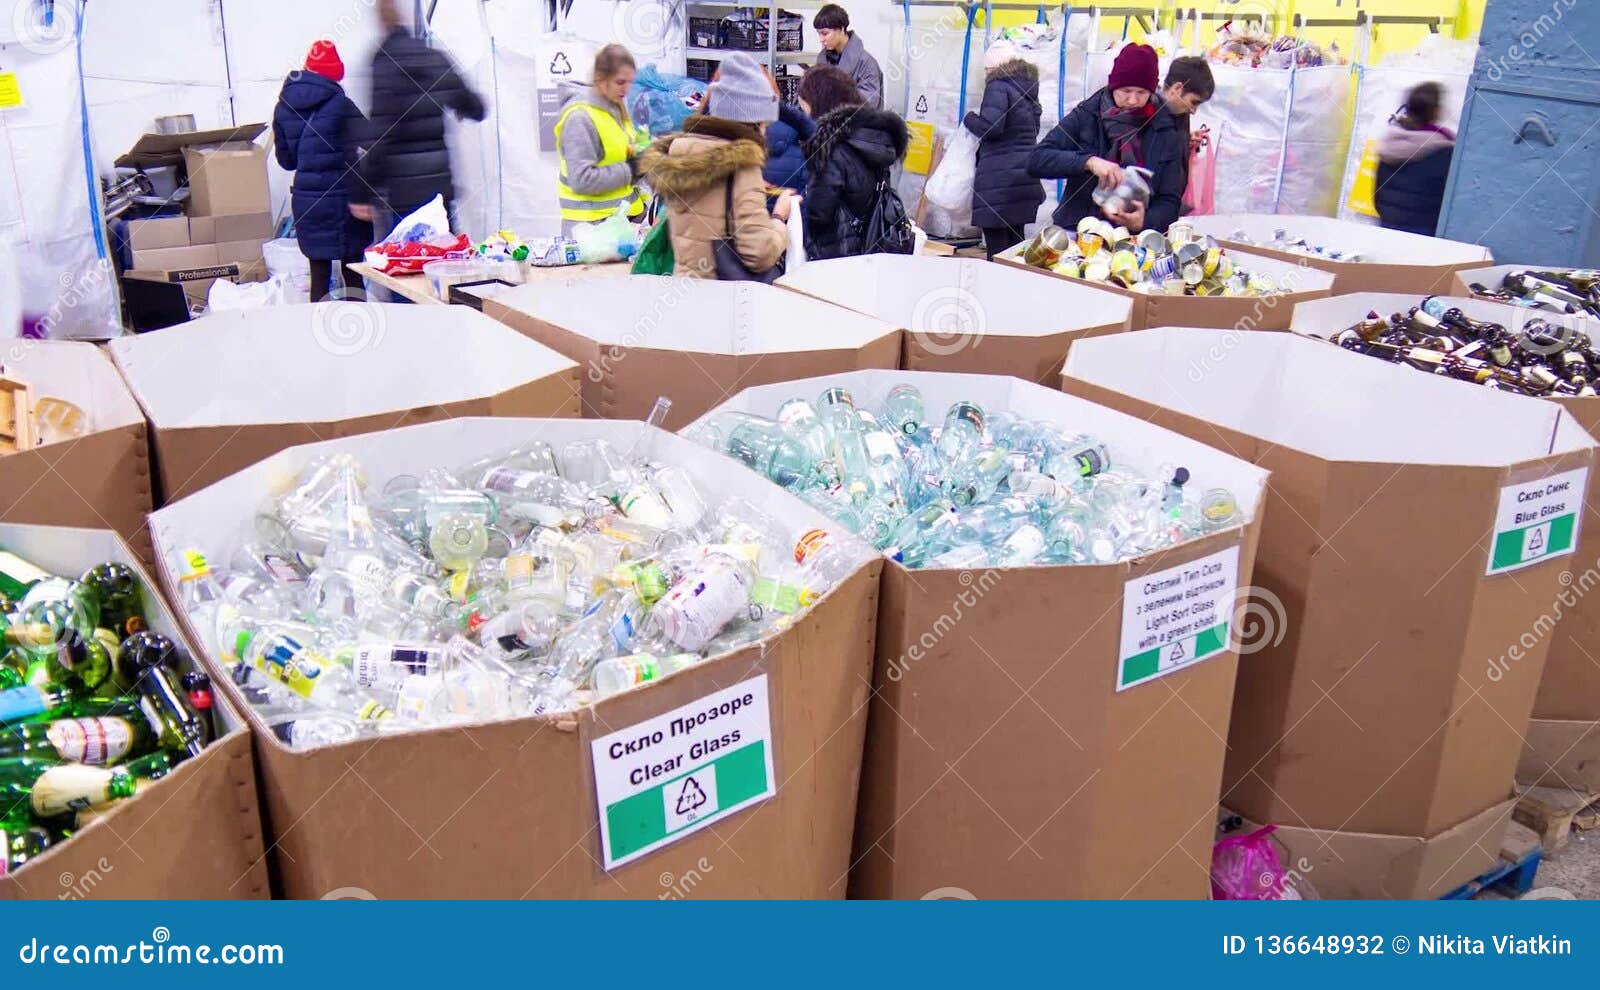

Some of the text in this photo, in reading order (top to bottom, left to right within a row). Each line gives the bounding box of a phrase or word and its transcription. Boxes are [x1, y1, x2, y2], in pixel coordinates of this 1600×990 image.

[178, 267, 230, 280] Professional
[1517, 489, 1544, 503] Скло
[1514, 503, 1566, 524] Blue Glass
[1146, 599, 1214, 631] Light Sort Glass
[1138, 634, 1158, 649] with
[1159, 633, 1165, 642] a
[1166, 623, 1192, 642] green
[608, 693, 753, 760] Скло Прозоре
[629, 729, 742, 786] Clear Glass
